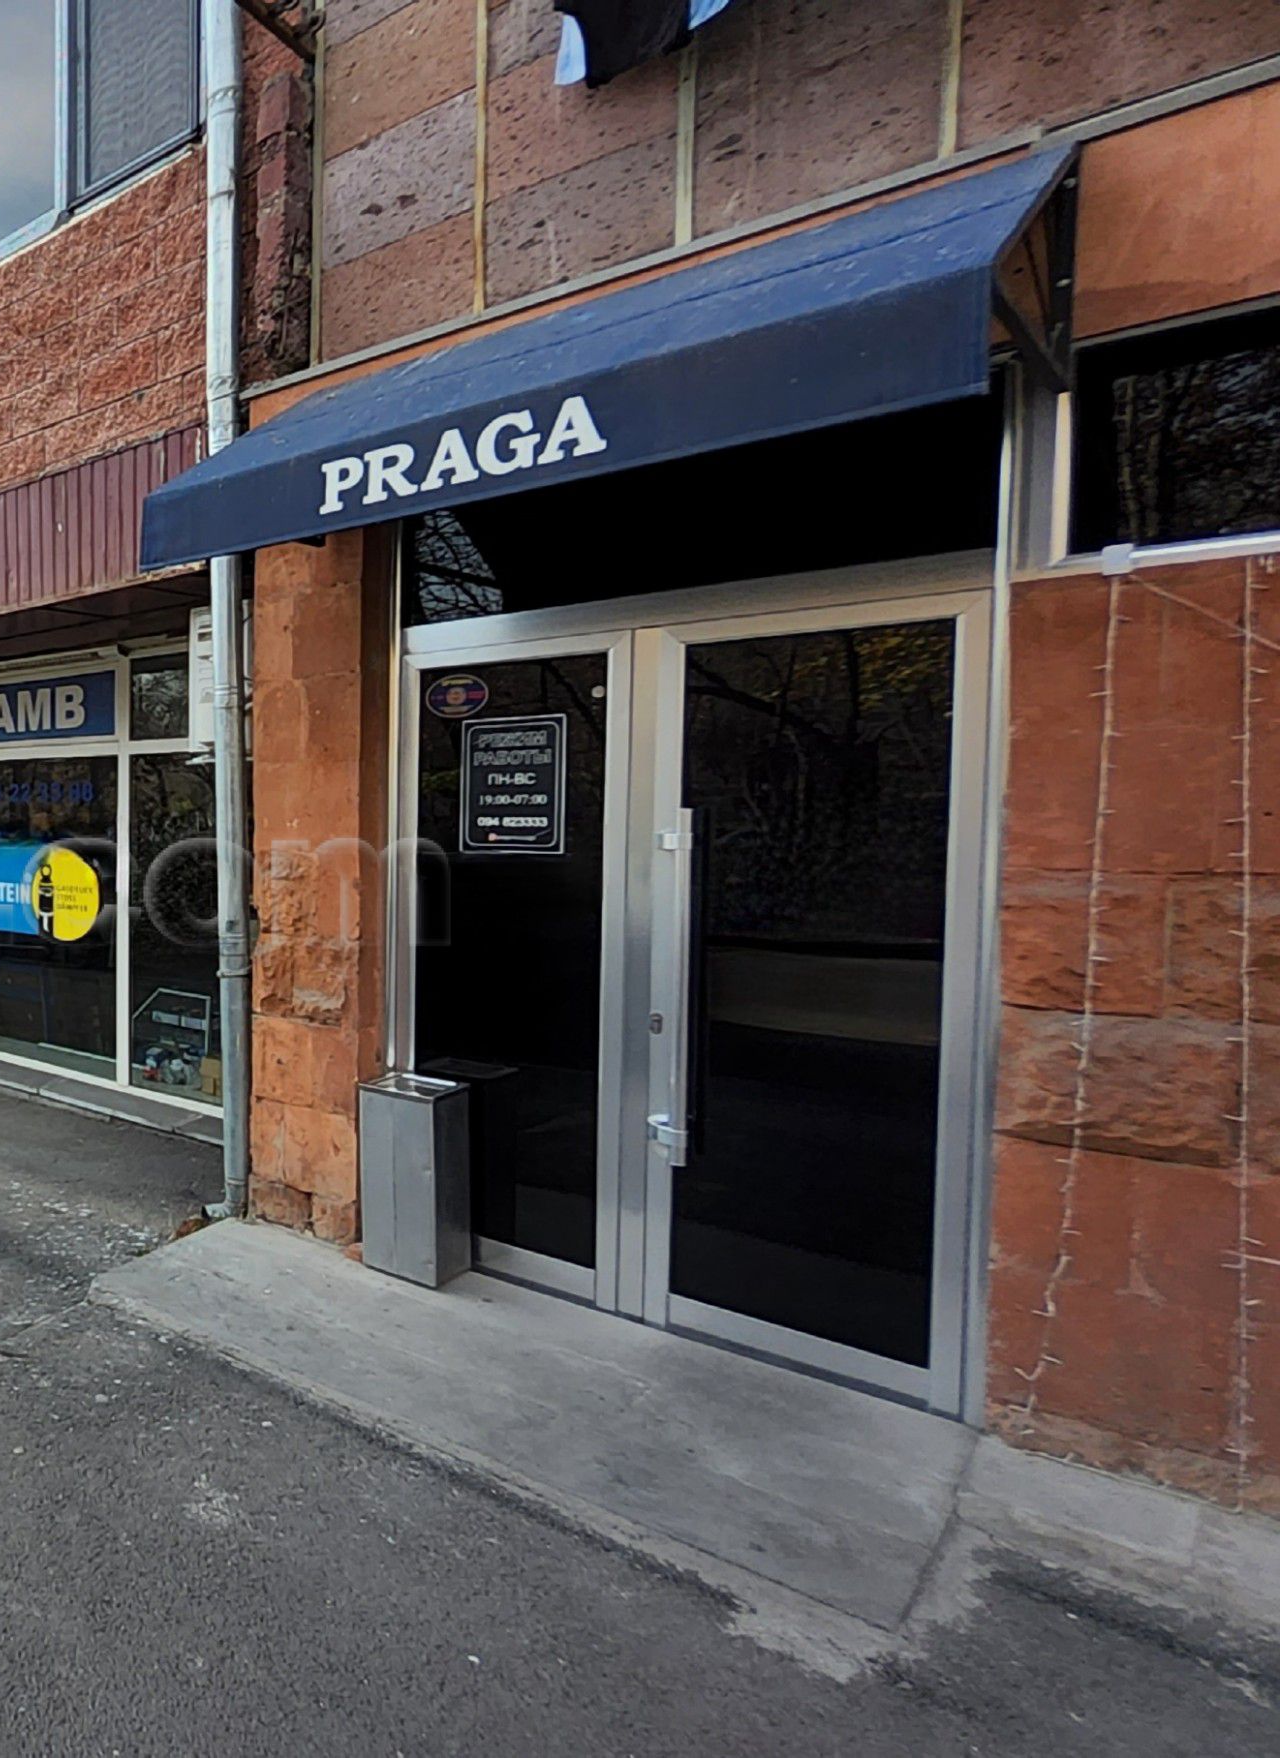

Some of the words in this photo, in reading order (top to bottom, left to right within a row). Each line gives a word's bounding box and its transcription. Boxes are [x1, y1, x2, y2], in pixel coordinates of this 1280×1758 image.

[318, 395, 607, 515] PRAGA
[473, 748, 552, 766] РАБОТЫ
[488, 773, 536, 785] ПН-ВС
[479, 795, 548, 806] 19:00-07:00
